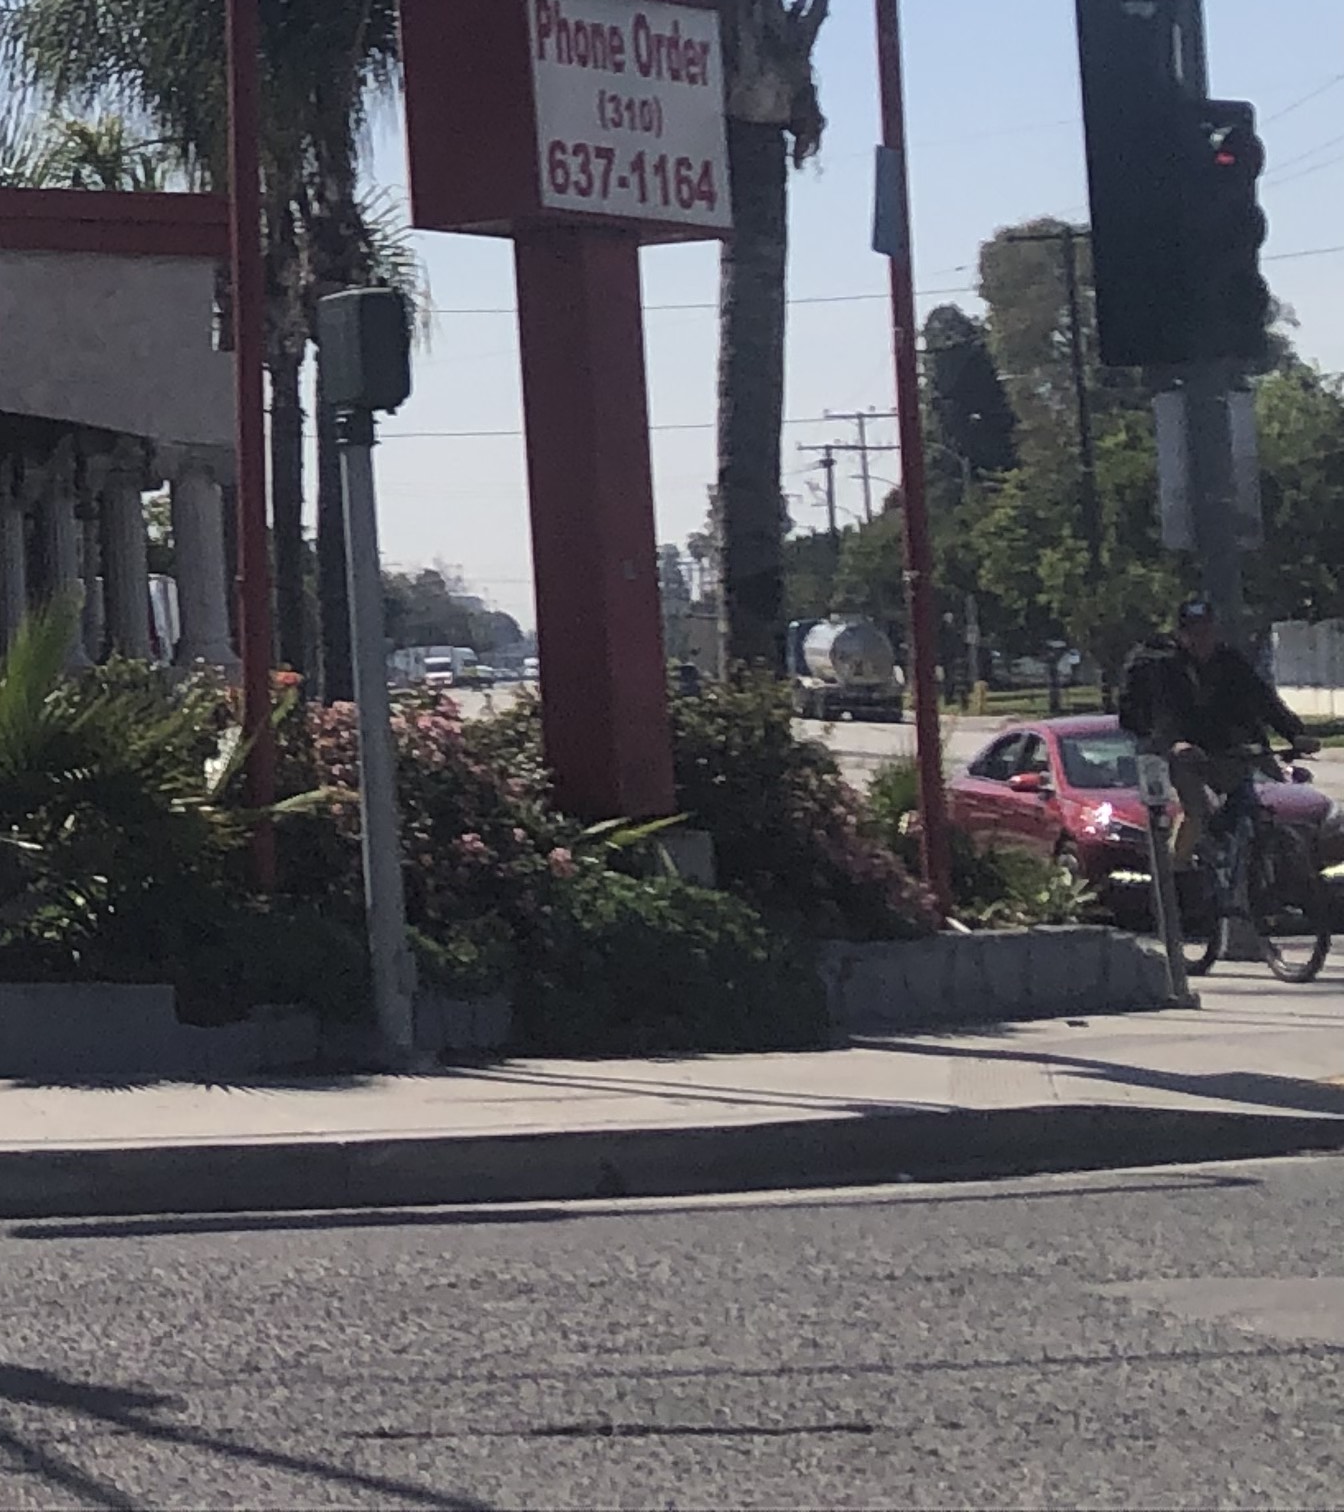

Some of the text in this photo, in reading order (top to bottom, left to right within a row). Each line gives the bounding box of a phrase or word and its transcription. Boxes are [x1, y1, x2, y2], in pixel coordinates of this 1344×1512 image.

[632, 12, 711, 87] Order
[598, 89, 664, 138] (310)
[548, 139, 717, 212] 637-1164
